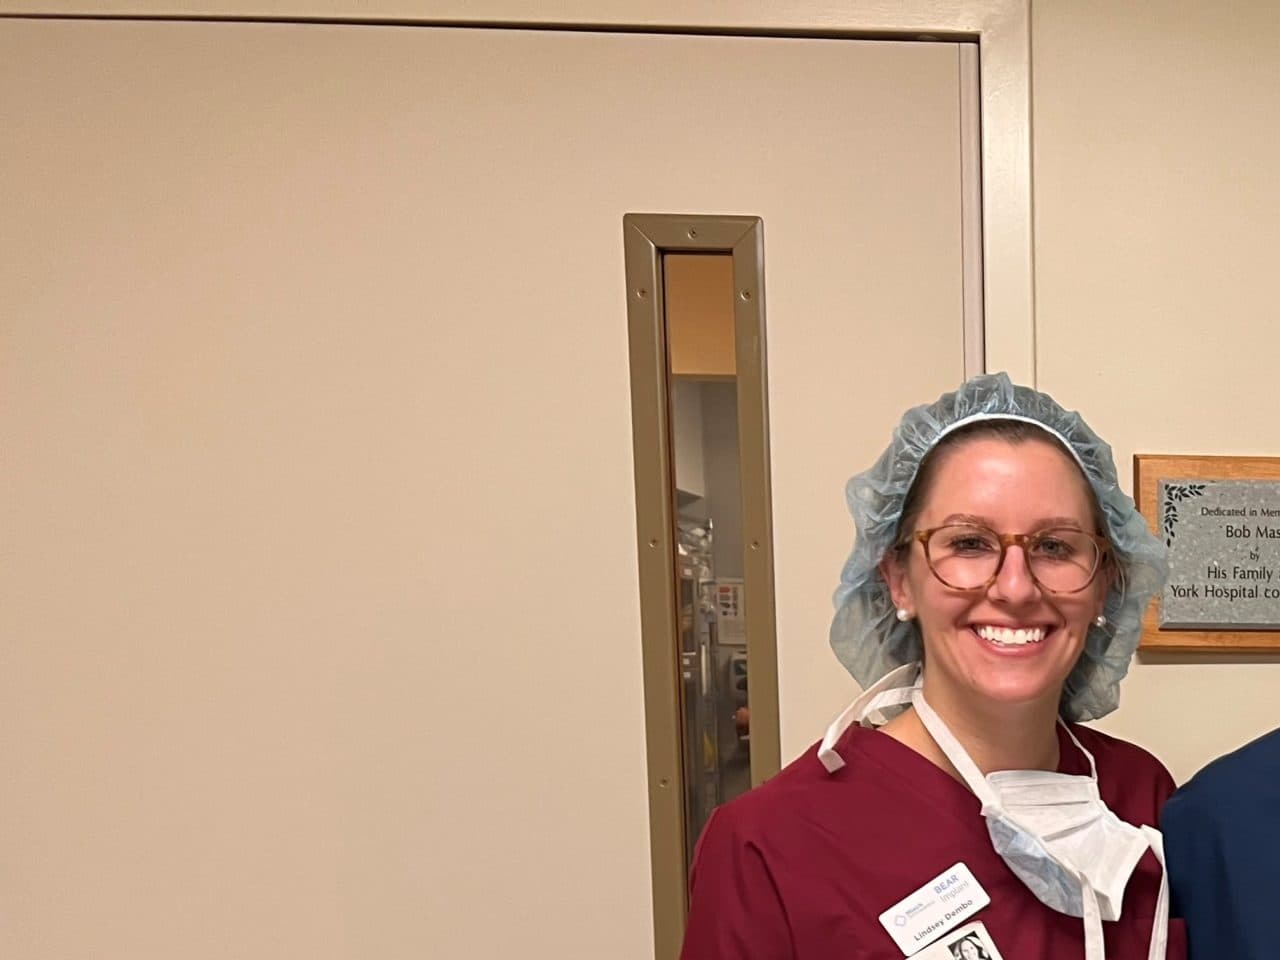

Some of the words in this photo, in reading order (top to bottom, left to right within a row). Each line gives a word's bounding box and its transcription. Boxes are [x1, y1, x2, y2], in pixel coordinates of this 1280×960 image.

[1200, 506, 1246, 517] Dedicated
[1249, 507, 1258, 517] in
[1226, 525, 1251, 538] Bob
[1249, 551, 1260, 562] by
[1207, 566, 1227, 580] His
[1233, 566, 1274, 583] Family
[1170, 584, 1200, 598] York
[1204, 584, 1259, 601] Hospital
[934, 874, 959, 894] BEAR
[913, 919, 945, 942] Lindsey
[944, 899, 974, 921] Dembo
